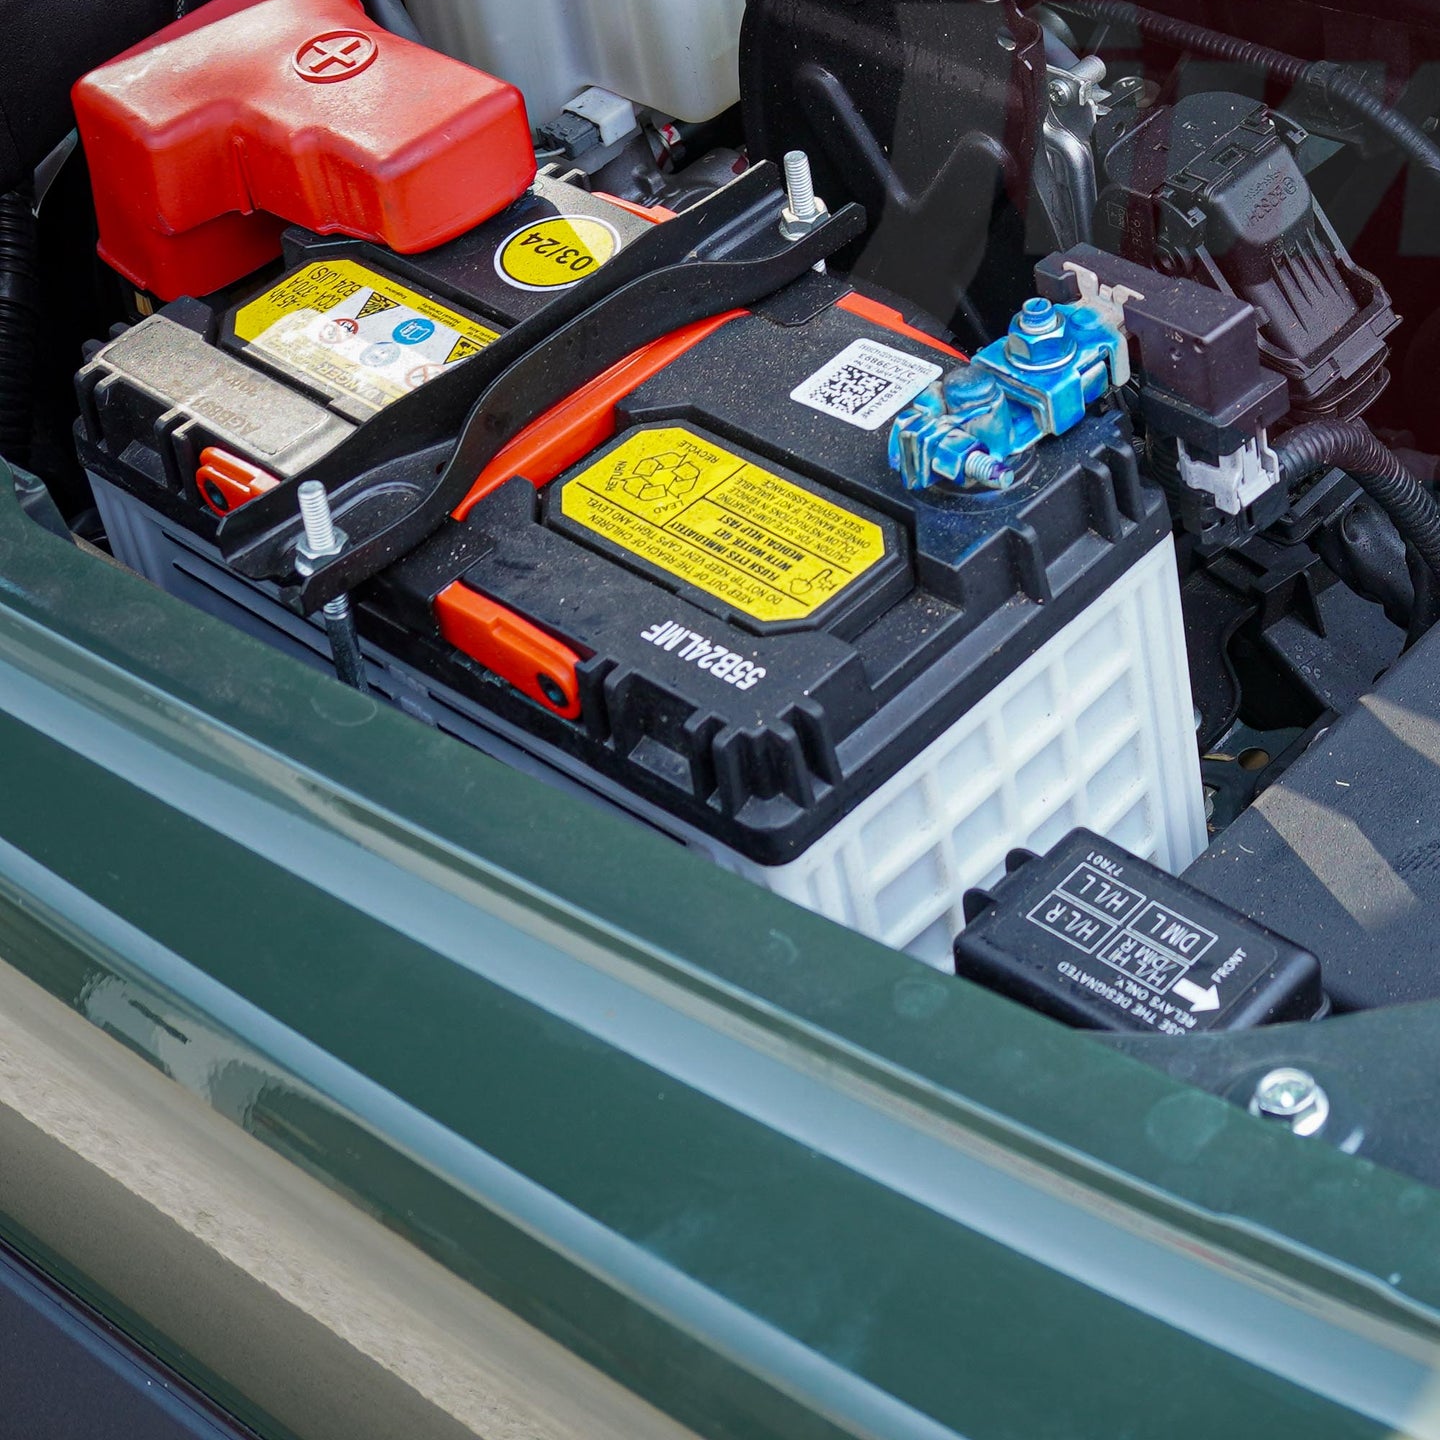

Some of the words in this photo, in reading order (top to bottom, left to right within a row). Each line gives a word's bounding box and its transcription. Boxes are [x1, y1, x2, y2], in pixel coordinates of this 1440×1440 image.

[520, 232, 593, 271] 03/24
[307, 265, 342, 286] (JIS)
[331, 279, 362, 297] B24
[313, 291, 341, 309] CCA
[604, 459, 628, 494] RETURN
[653, 499, 685, 515] LEAD
[719, 514, 742, 528] FAST
[669, 521, 728, 554] IMMEDIATELY
[741, 526, 763, 539] HELP
[728, 551, 749, 564] EYES
[763, 536, 804, 560] MEDICAL
[750, 563, 779, 580] FLUSH
[764, 554, 792, 570] WITH
[641, 620, 766, 691] 55B24LMF
[1079, 874, 1096, 895] L
[1095, 881, 1129, 913] H/L
[1045, 902, 1067, 921] R
[1065, 910, 1100, 942] H/L
[1150, 912, 1167, 935] L
[1120, 937, 1137, 951] R
[1160, 922, 1201, 954] DIM
[1107, 949, 1131, 966] HI
[1211, 947, 1247, 983] FRONT
[1133, 959, 1168, 987] H/L
[1056, 961, 1132, 1010] DESIGNATED
[1130, 1003, 1156, 1024] THE
[1152, 995, 1197, 1028] RELAYS
